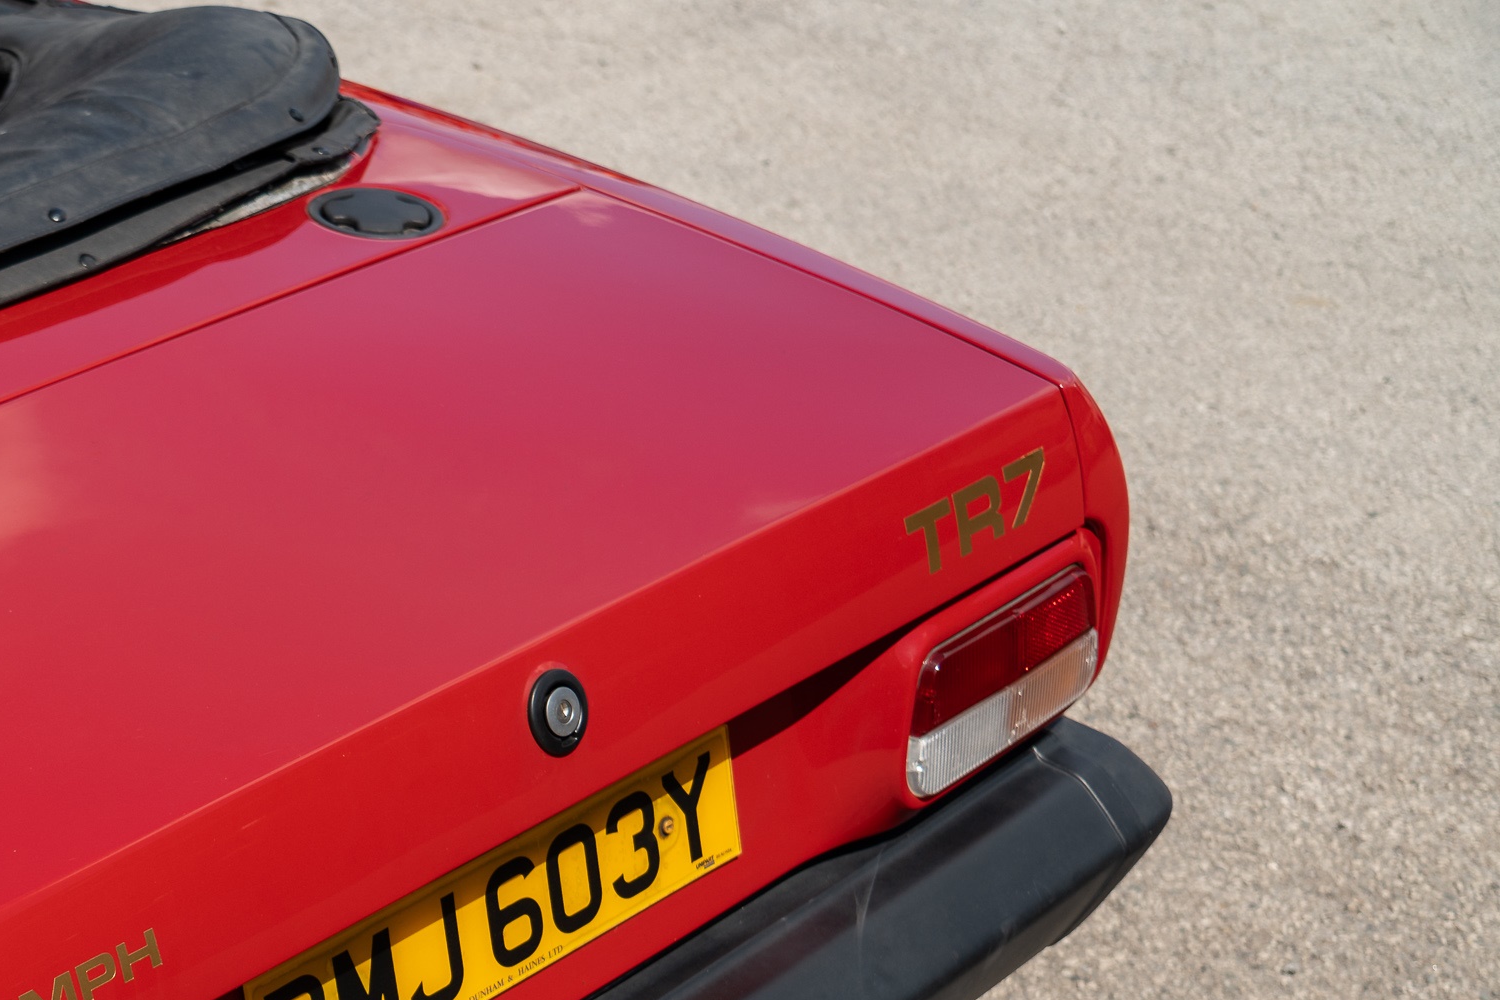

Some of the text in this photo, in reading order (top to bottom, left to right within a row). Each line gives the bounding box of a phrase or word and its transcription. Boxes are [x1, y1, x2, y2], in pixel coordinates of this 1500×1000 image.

[903, 446, 1045, 574] TR7
[485, 751, 710, 968] 603Y
[507, 974, 514, 983] &
[517, 955, 546, 977] HAINES
[548, 944, 564, 959] LTD
